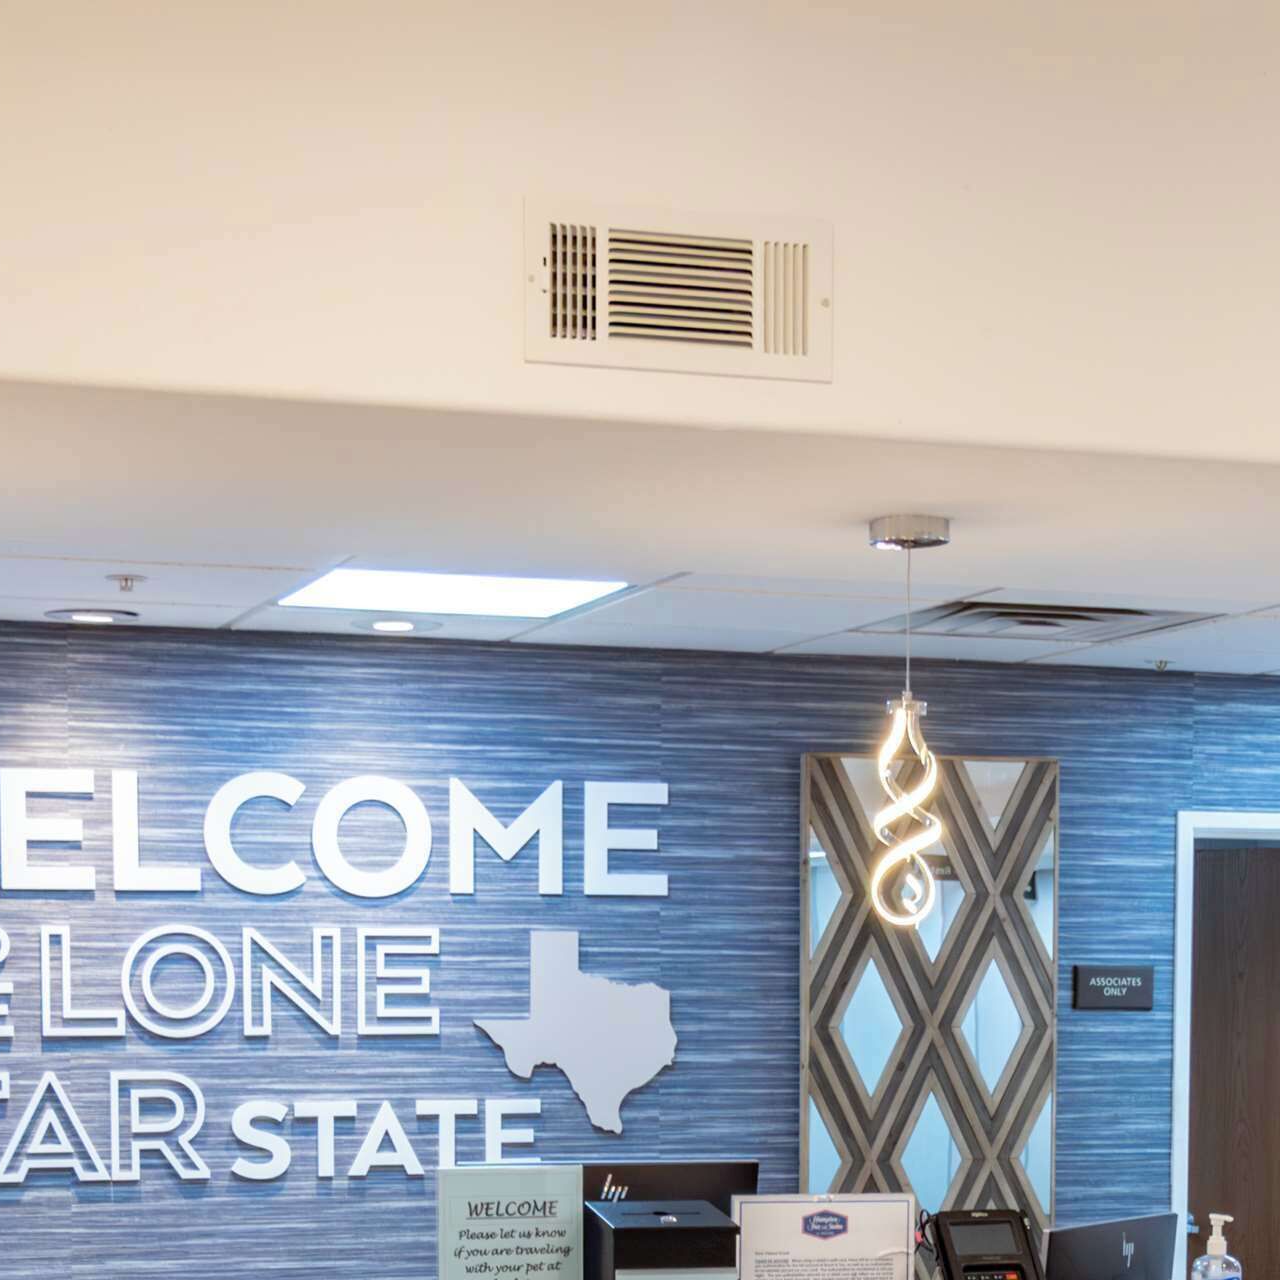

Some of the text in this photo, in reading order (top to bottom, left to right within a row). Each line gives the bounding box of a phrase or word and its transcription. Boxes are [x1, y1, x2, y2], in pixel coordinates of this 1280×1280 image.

[41, 925, 441, 1040] LONE
[1089, 977, 1142, 986] ASSOCIATES
[1103, 987, 1127, 996] ONLY
[230, 1098, 541, 1180] STATE
[467, 1199, 559, 1217] WELCOME
[458, 1227, 567, 1240] Please let us know
[454, 1244, 574, 1260] if you are traveling
[465, 1261, 562, 1276] with your pet at
